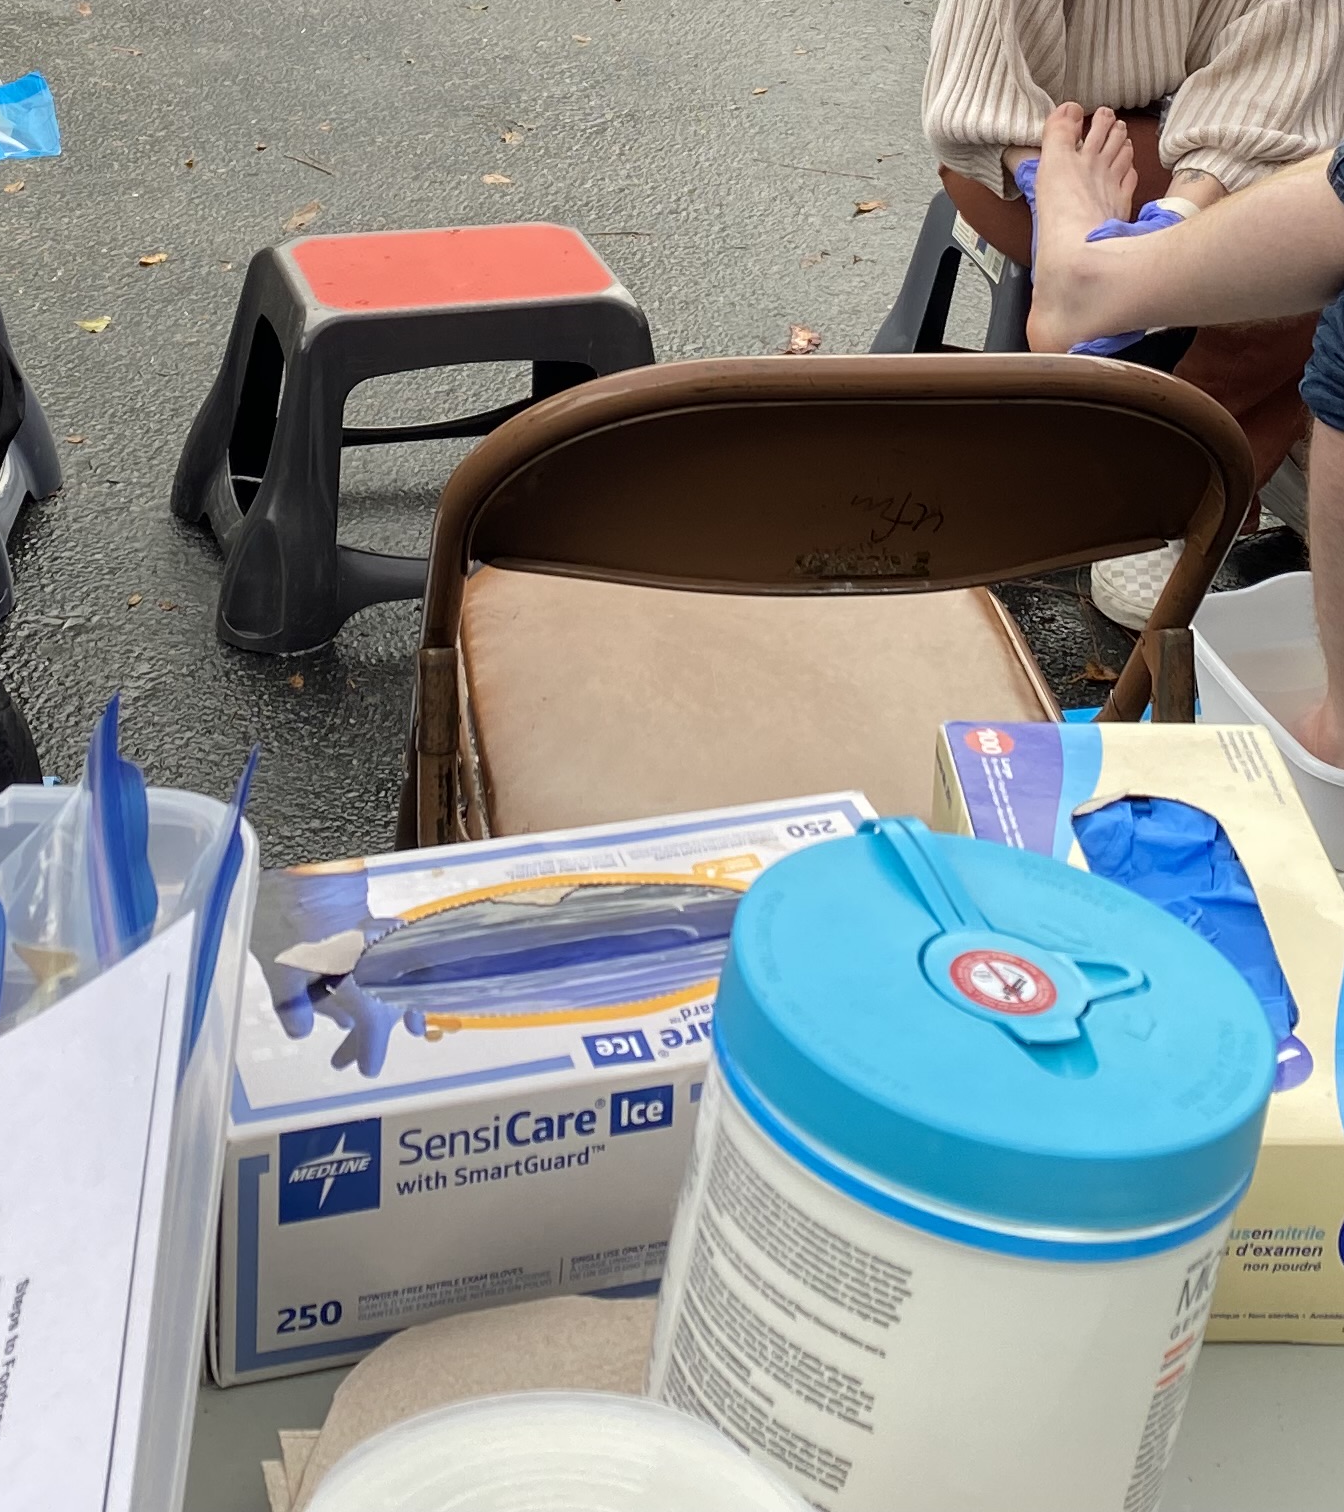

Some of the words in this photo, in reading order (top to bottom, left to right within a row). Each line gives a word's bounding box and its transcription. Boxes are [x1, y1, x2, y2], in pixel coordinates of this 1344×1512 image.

[787, 818, 838, 839] 250
[594, 1034, 643, 1059] Ice
[619, 1096, 665, 1128] Ice
[288, 1154, 372, 1185] MEDLINE
[396, 1171, 448, 1196] with
[1236, 1243, 1324, 1258] d'examen
[1242, 1262, 1271, 1272] non
[1272, 1261, 1323, 1275] poudré
[8, 1277, 30, 1333] Steps
[276, 1299, 343, 1336] 250
[4, 1335, 20, 1355] to
